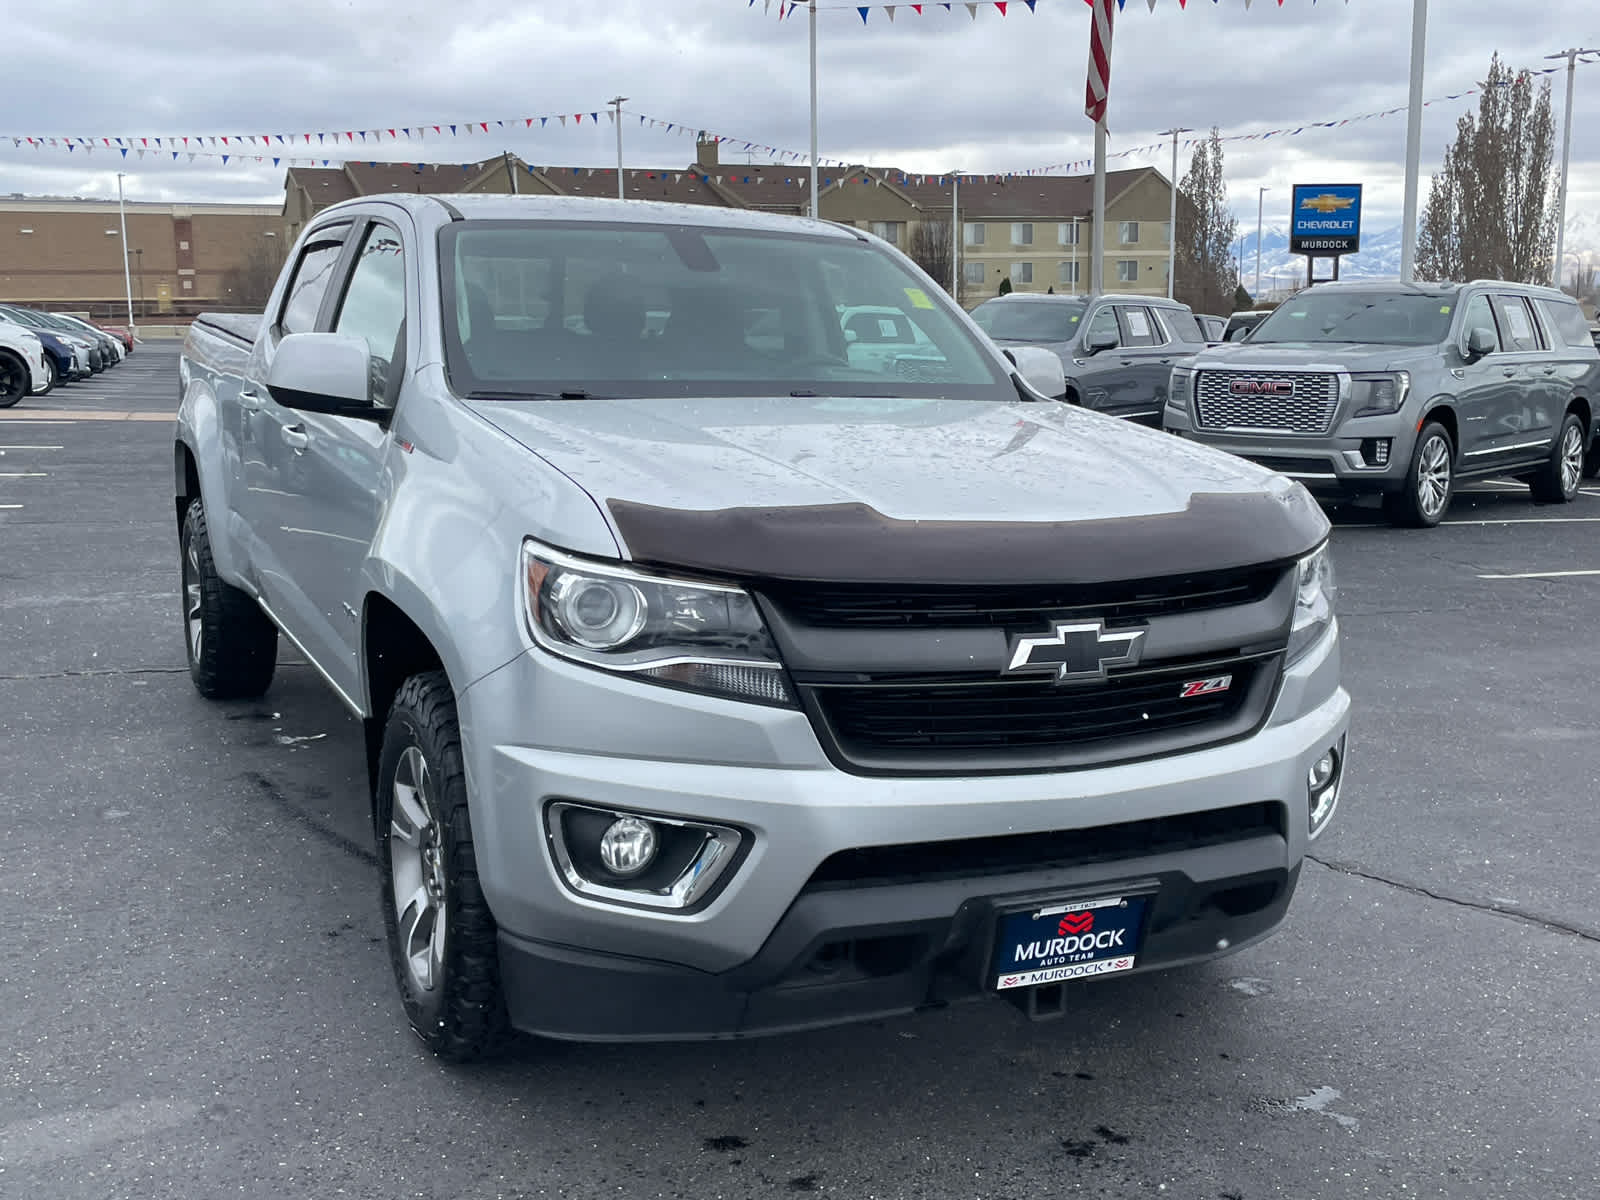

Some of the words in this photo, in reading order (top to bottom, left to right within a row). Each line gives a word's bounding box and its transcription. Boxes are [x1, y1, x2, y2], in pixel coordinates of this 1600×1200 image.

[1297, 220, 1354, 229] CHEVROLET
[1301, 240, 1348, 249] MURDOCK
[1231, 381, 1292, 394] GMC
[1179, 675, 1232, 697] Z71
[1014, 928, 1126, 962] MURDOCK
[1039, 957, 1066, 967] AUTO
[1069, 952, 1094, 962] TEAM
[1031, 961, 1105, 983] MURDOCK
